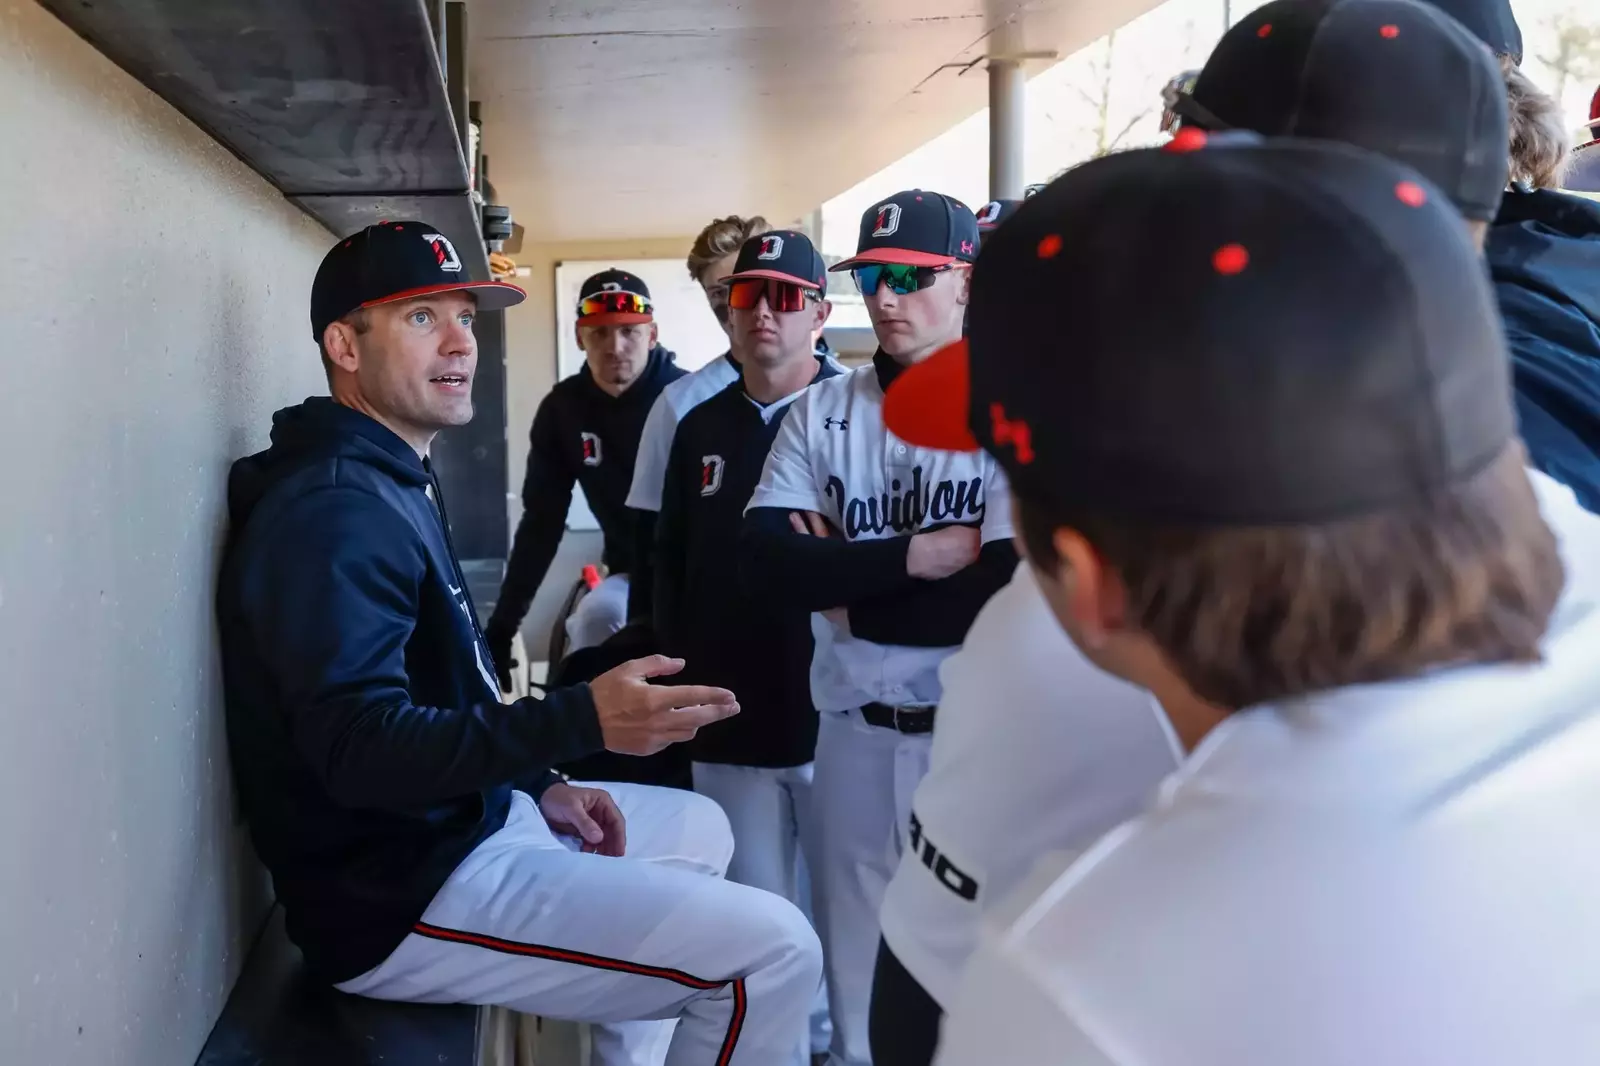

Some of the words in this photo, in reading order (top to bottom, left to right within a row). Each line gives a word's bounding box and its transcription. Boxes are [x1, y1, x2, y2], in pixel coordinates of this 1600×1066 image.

[871, 203, 902, 238] D
[422, 233, 462, 272] D
[757, 235, 784, 260] D
[580, 431, 602, 467] D
[700, 454, 725, 497] D
